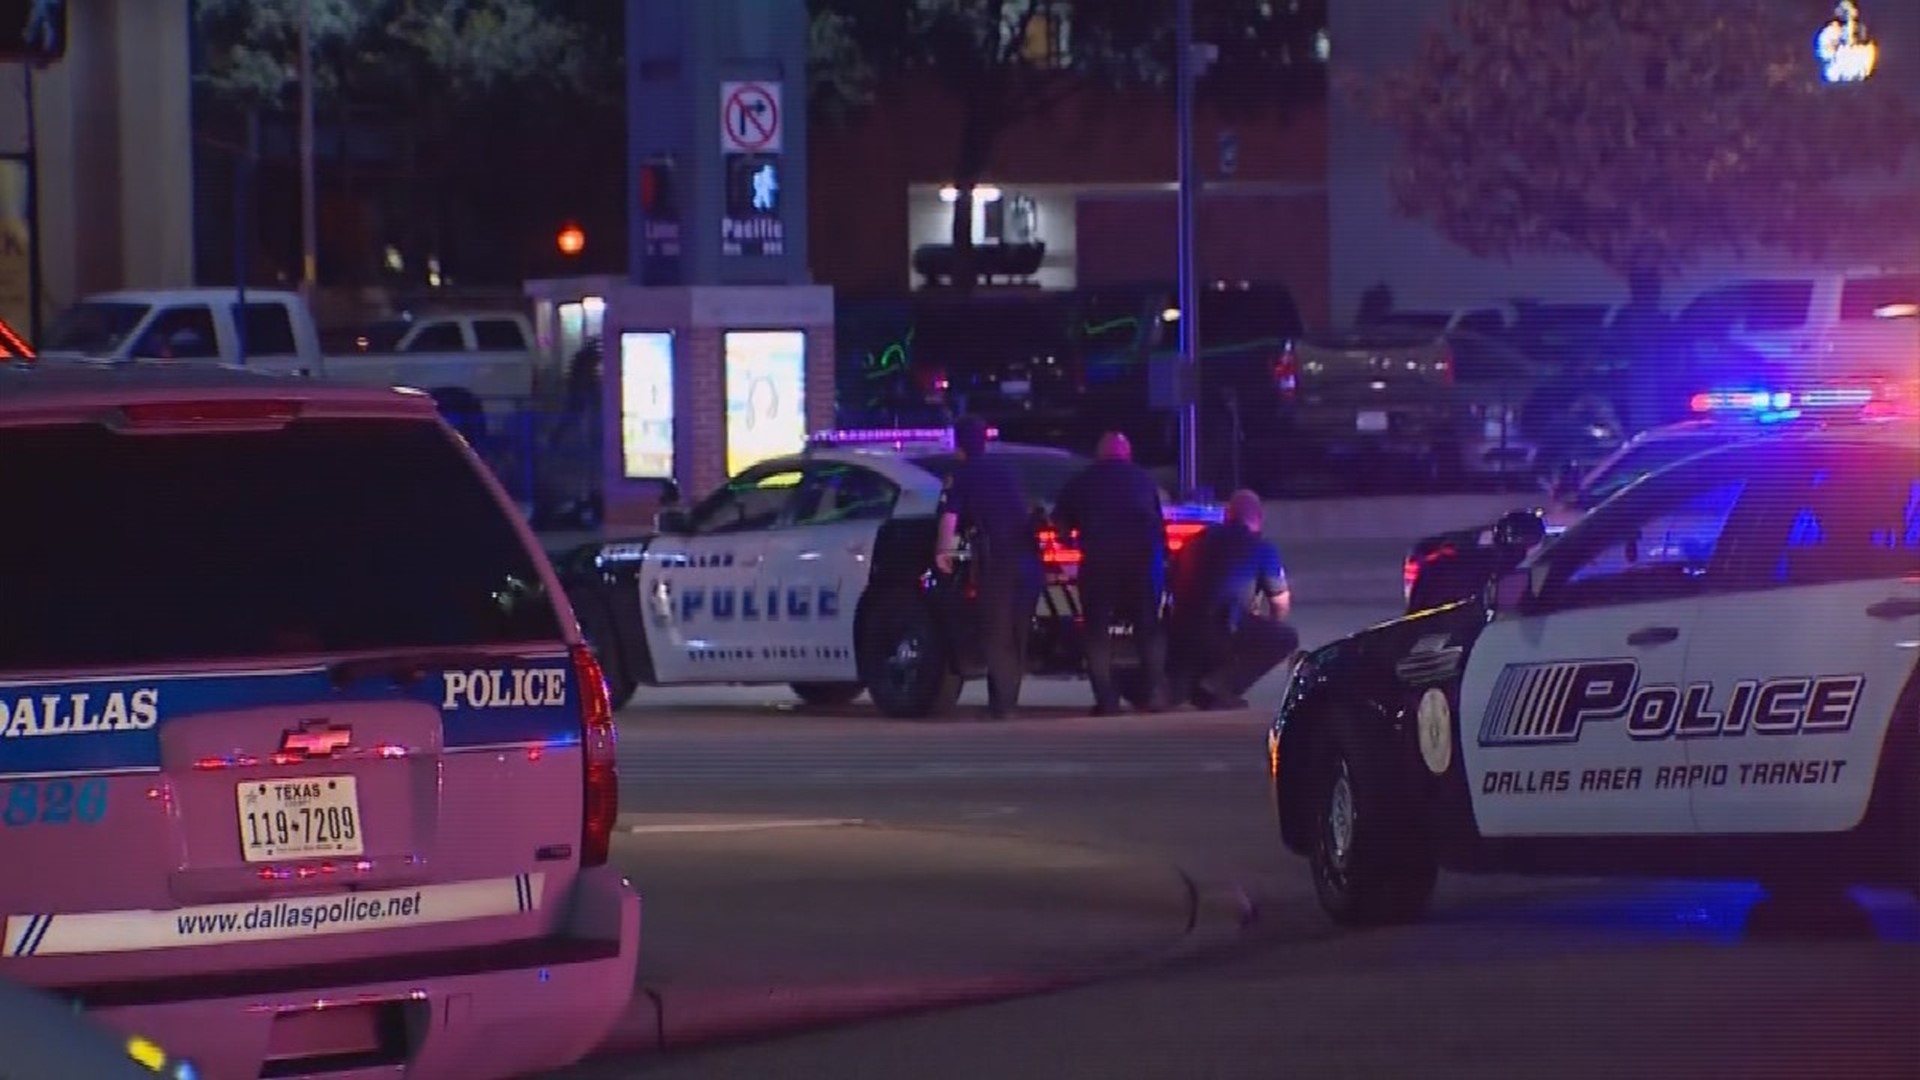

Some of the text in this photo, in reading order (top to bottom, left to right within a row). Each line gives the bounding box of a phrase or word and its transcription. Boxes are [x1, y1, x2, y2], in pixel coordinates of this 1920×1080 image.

[722, 218, 782, 238] Pacific
[681, 586, 841, 622] POLICE
[442, 668, 566, 710] POLICE
[1549, 656, 1867, 740] POLICE
[275, 784, 321, 801] TEXAS
[1482, 760, 1847, 795] DALLAS AREA RAPID TRANSIT
[177, 892, 421, 935] www.dallaspolice.net
